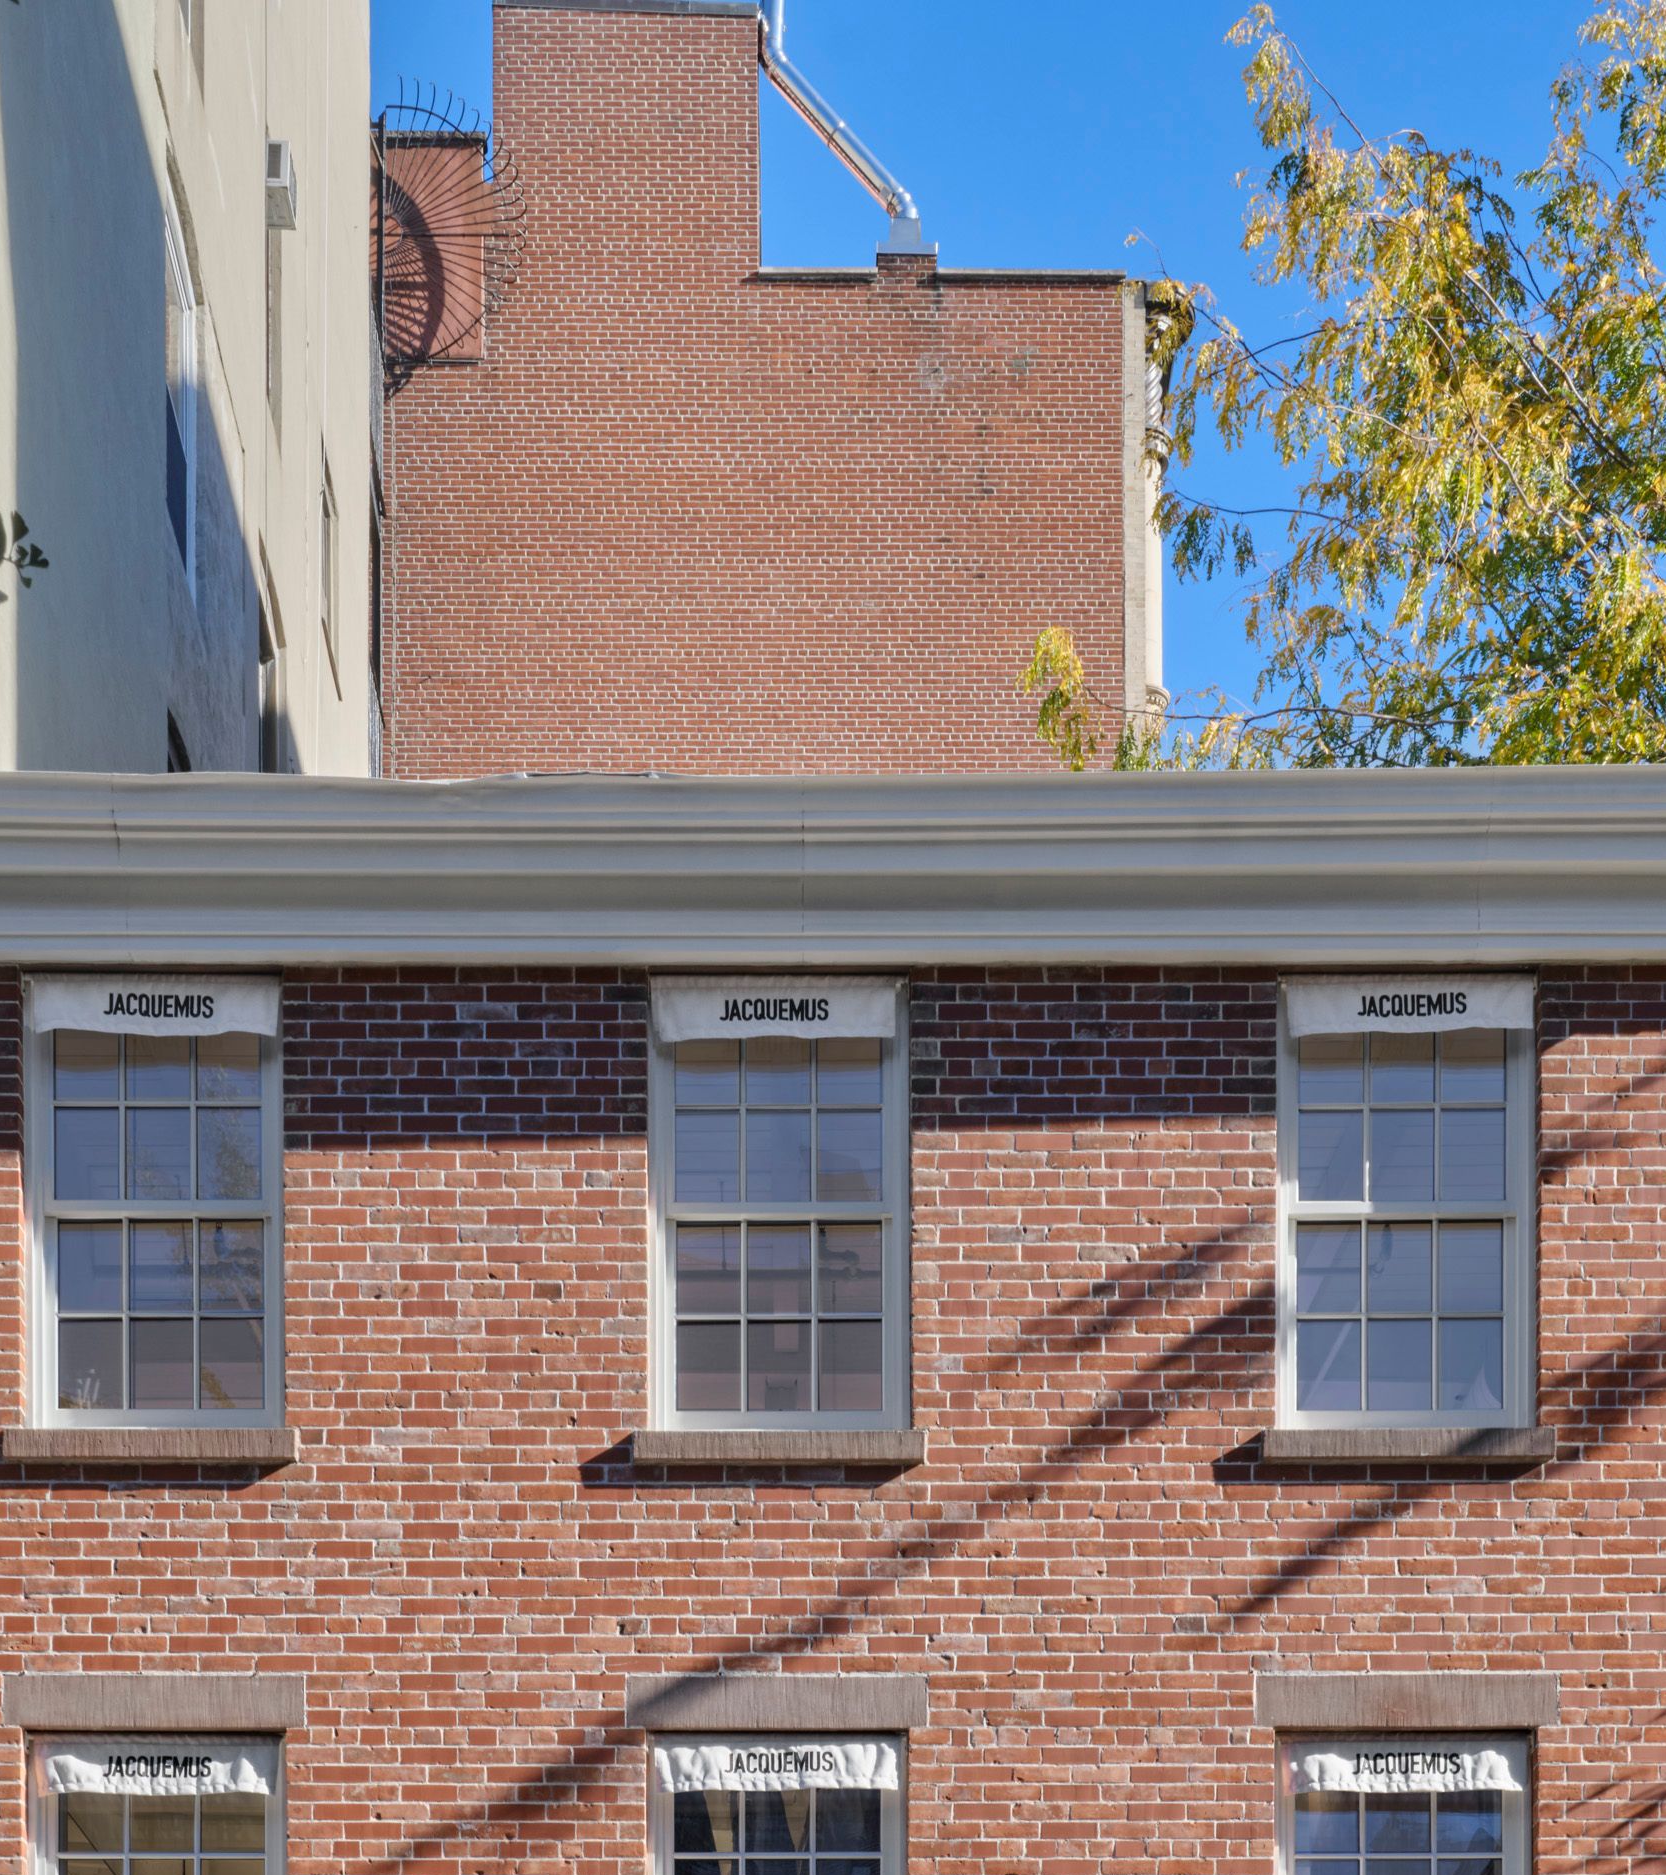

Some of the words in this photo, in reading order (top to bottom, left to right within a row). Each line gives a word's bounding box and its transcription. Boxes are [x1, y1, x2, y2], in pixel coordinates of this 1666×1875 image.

[103, 992, 215, 1019] JACQUEMUS
[719, 998, 829, 1022] JACQUEMUS
[1357, 992, 1467, 1018] JACQUEMUS
[103, 1755, 212, 1778] JACQUEMUS
[724, 1751, 833, 1774] JACQUEMUS
[1352, 1752, 1461, 1775] JACQUEMUS
